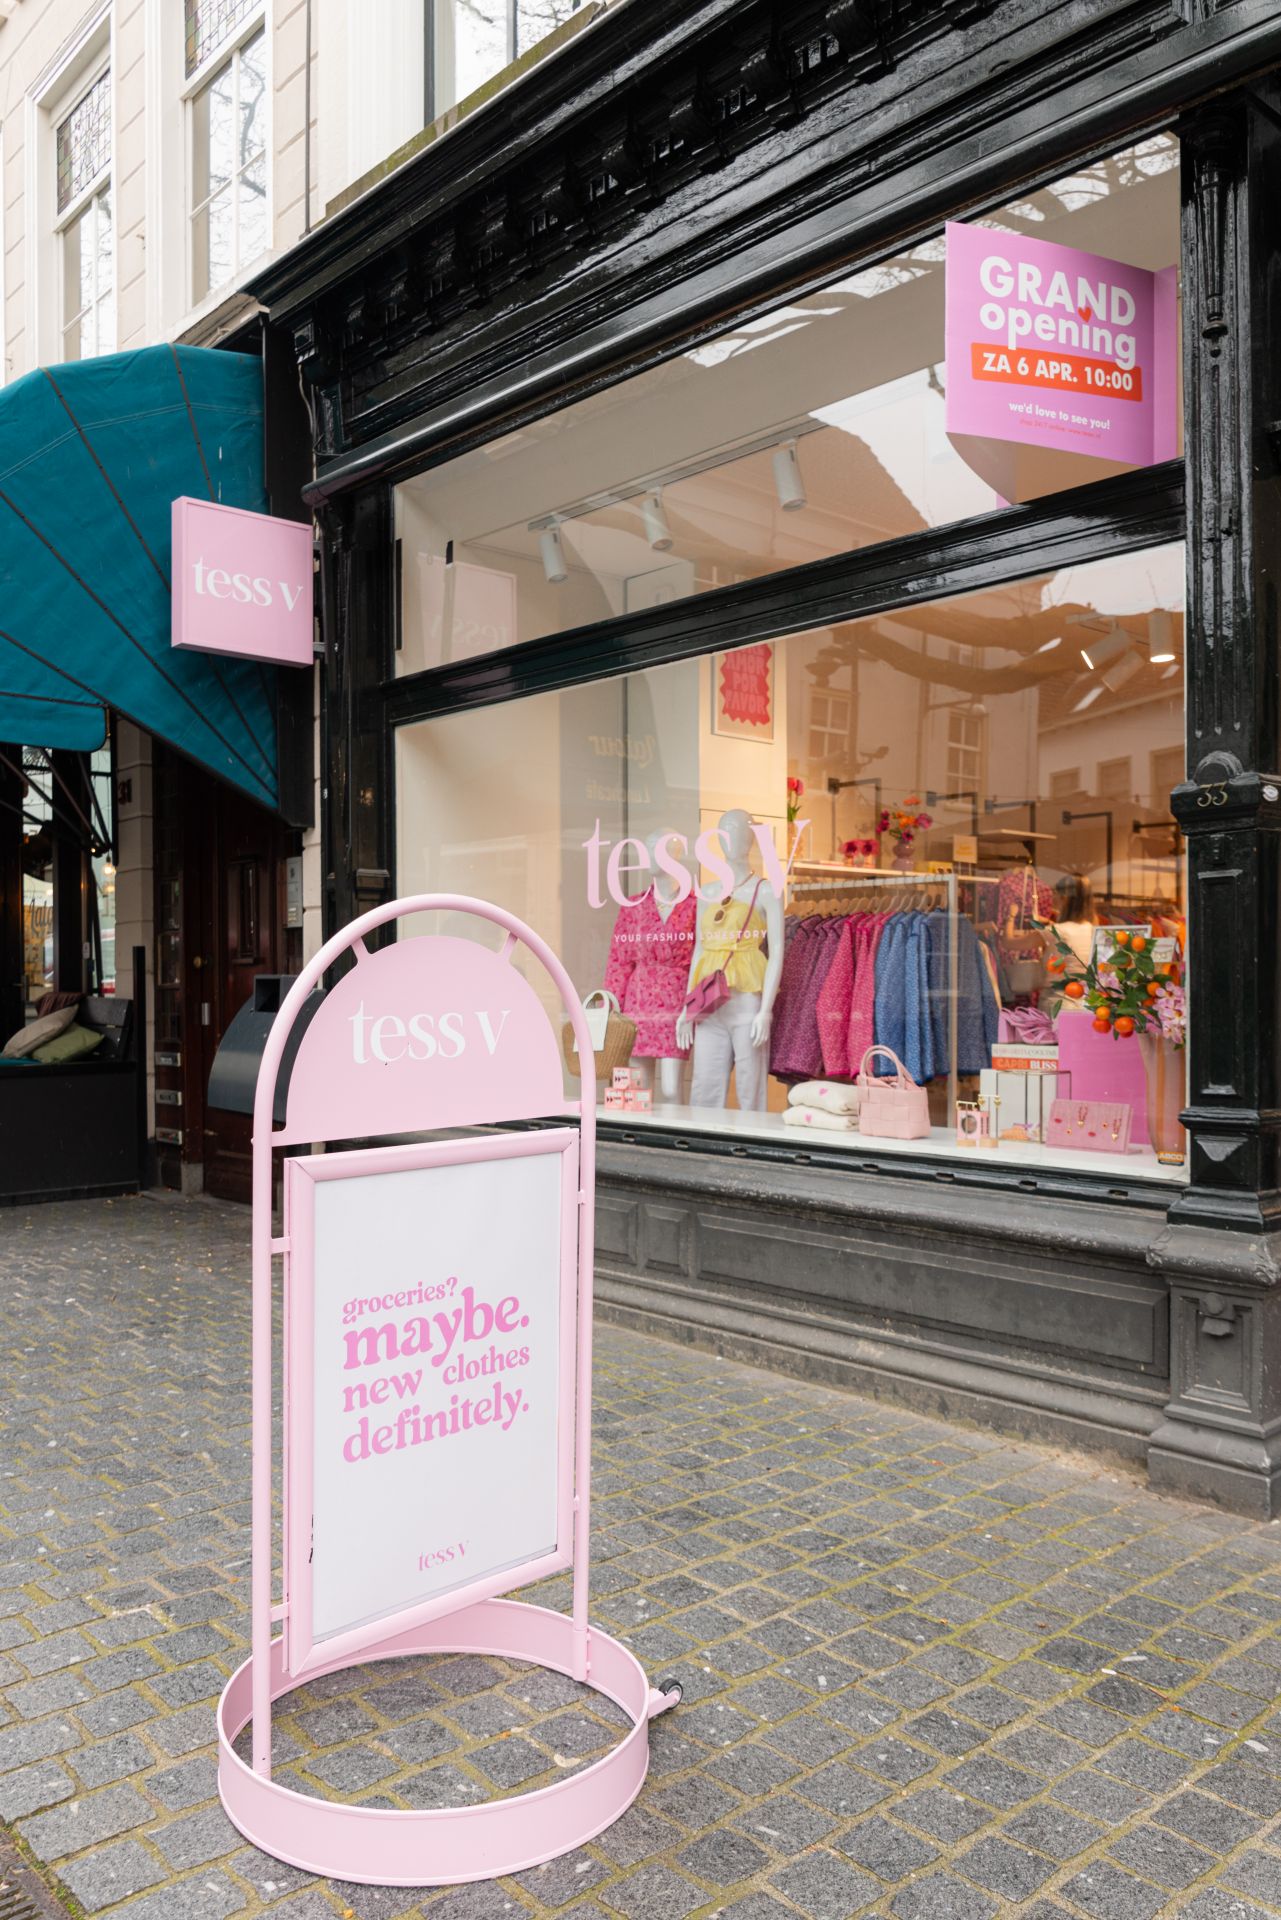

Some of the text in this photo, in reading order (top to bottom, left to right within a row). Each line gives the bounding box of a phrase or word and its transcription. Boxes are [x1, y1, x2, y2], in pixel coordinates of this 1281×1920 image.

[979, 256, 1136, 327] GRAND
[979, 302, 1136, 371] opening
[982, 352, 1133, 391] ZA 6 APR. 10:00
[1008, 402, 1032, 414] we'd
[1035, 405, 1056, 418] love
[1059, 411, 1069, 421] to
[1072, 415, 1088, 425] see
[1090, 419, 1110, 430] you!
[192, 556, 304, 612] tess v
[725, 689, 766, 716] FAVOR
[732, 671, 759, 694] POR
[1197, 780, 1228, 807] 33
[581, 818, 736, 909] tess
[614, 933, 641, 943] YOUR
[646, 932, 694, 942] FASHION
[348, 1000, 511, 1064] tess v
[996, 1058, 1057, 1070] CAPRI BLISS
[342, 1276, 458, 1325] groceries?
[342, 1286, 530, 1370] maybe.
[342, 1345, 530, 1412] new clothes
[342, 1381, 529, 1463] definitely.
[418, 1546, 455, 1571] tess
